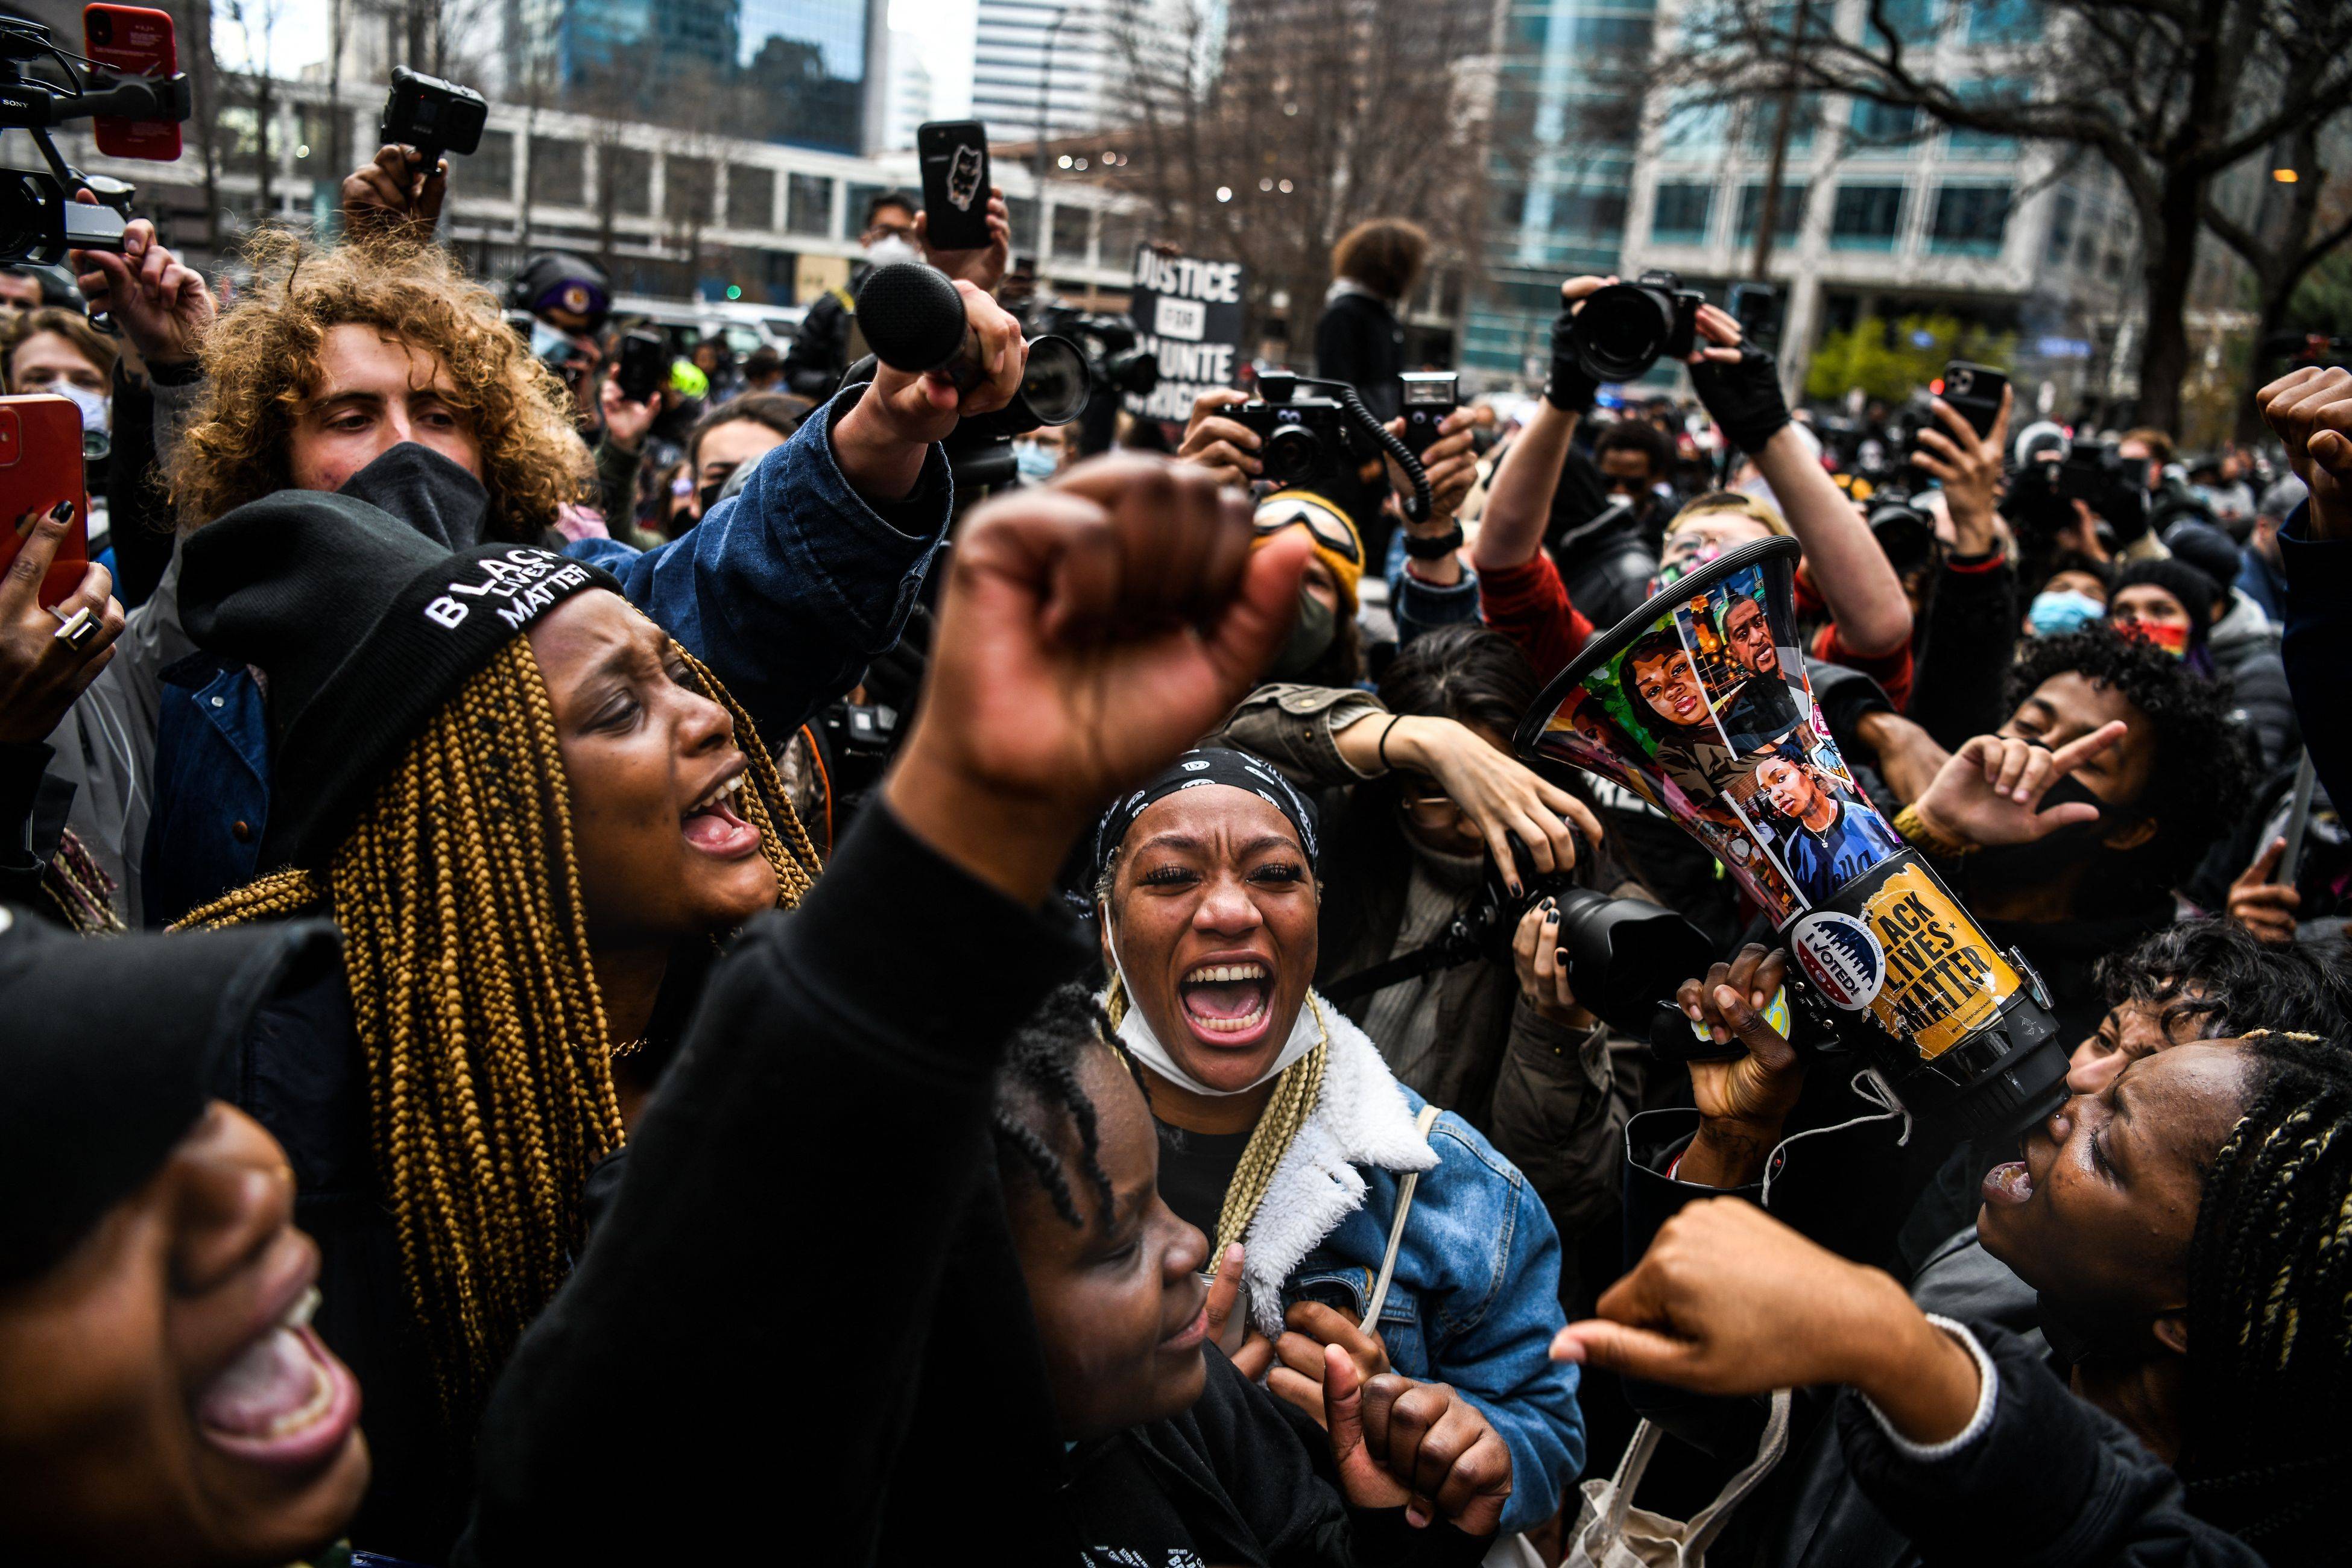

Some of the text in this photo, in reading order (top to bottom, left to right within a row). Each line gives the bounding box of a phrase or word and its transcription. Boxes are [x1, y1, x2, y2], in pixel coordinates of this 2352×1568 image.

[3, 99, 30, 109] SONY
[1136, 249, 1242, 303] JUSTICE
[1147, 335, 1234, 384] UNTE
[424, 548, 560, 630] BLACK
[490, 561, 555, 597] LIVES
[496, 563, 592, 631] MATTER
[1868, 935, 1882, 958] ELECTIONS
[1877, 891, 1935, 957] ACK
[1805, 932, 1815, 943] I
[1813, 942, 1860, 997] VOTED!
[1885, 920, 1955, 993] LIVES
[1814, 993, 1828, 1008] SIREN
[1900, 946, 1991, 1032] MATTER
[1810, 1012, 1819, 1022] OFF
